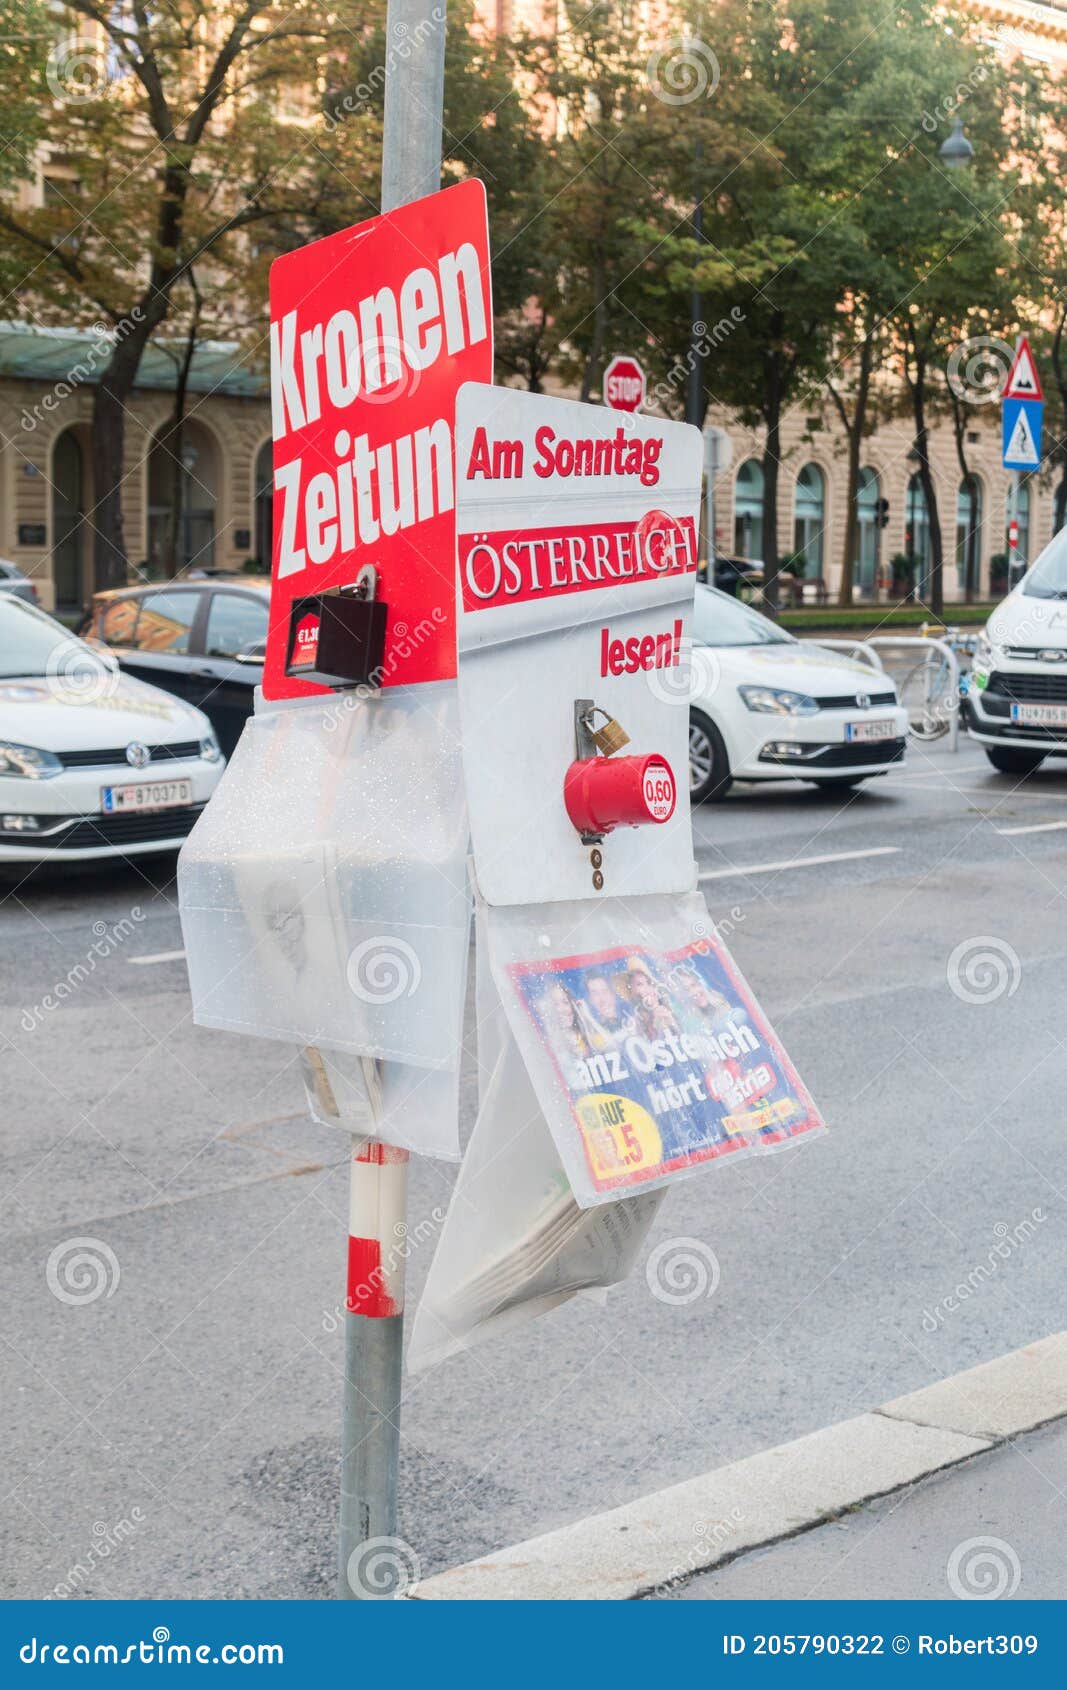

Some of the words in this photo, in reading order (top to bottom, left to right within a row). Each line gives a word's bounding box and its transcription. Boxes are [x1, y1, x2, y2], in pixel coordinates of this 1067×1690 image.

[270, 242, 487, 441] Kronen
[609, 376, 641, 401] STOP
[466, 427, 523, 480] Am
[533, 425, 663, 486] Sonntag
[274, 418, 454, 580] Zeitun
[465, 526, 696, 599] ÖSTERREICH
[600, 619, 683, 678] lesen!
[646, 780, 671, 805] 0,60
[572, 1050, 630, 1090] anz
